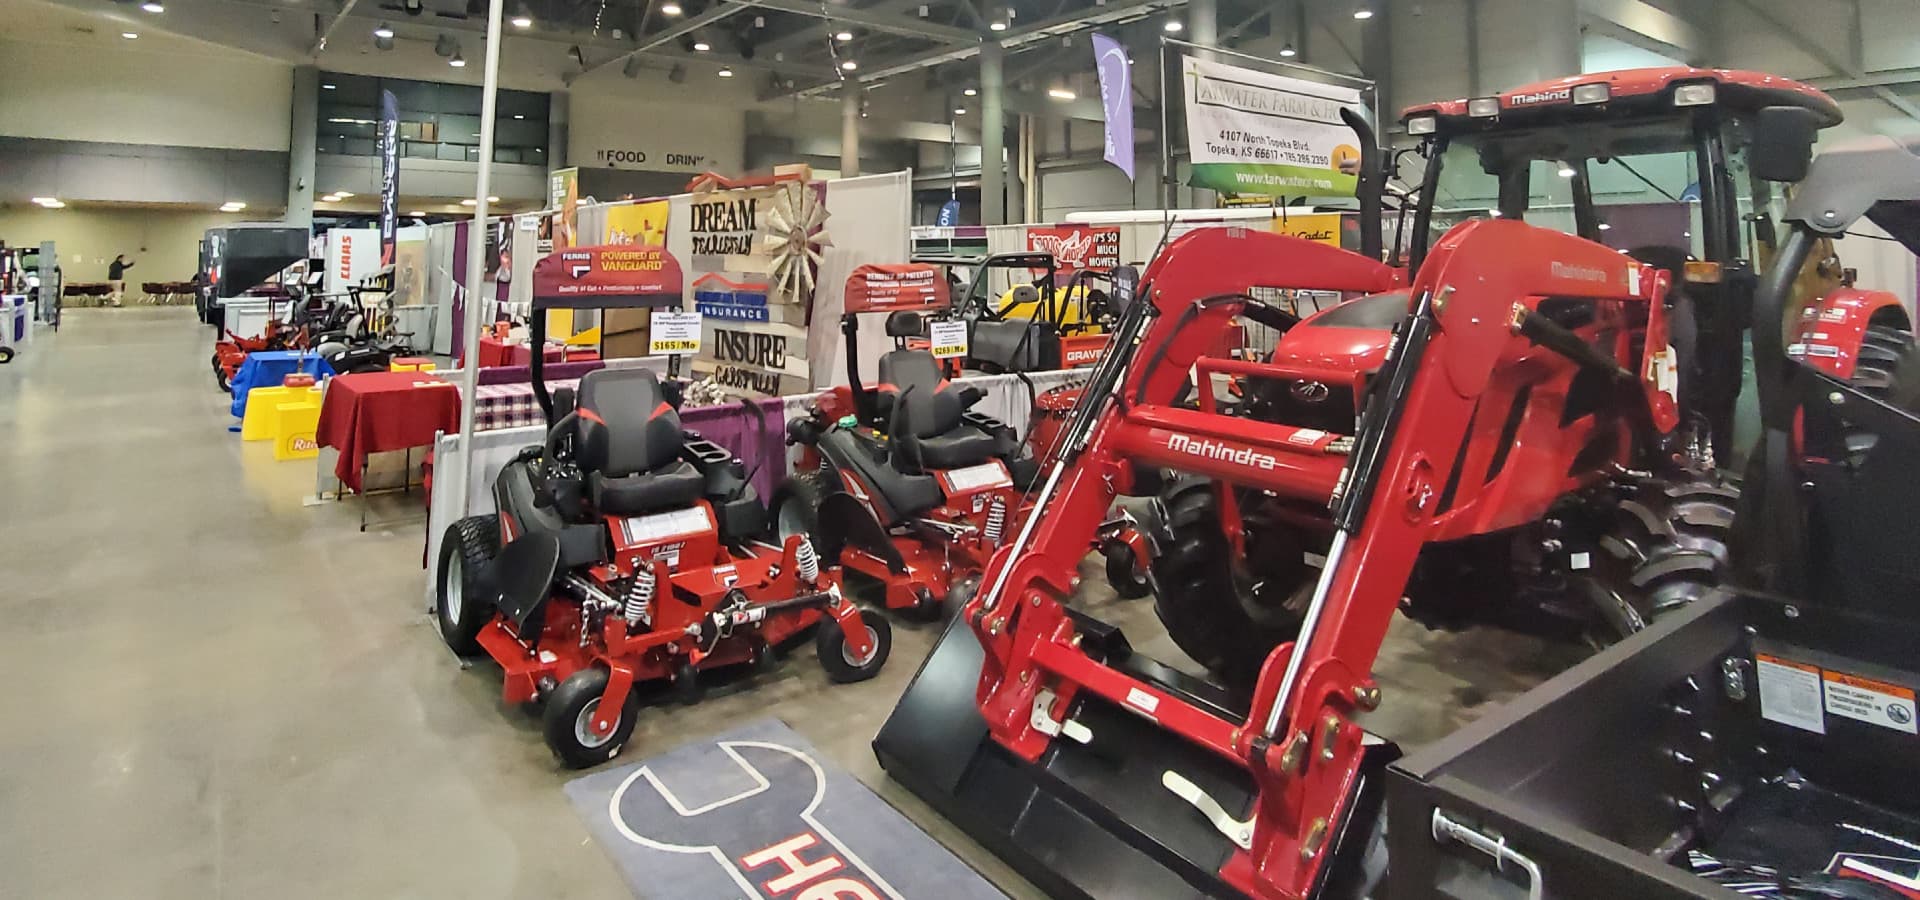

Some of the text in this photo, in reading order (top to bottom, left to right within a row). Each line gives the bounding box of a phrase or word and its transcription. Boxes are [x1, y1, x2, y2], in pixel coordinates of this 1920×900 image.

[1273, 93, 1307, 117] FARM
[1311, 105, 1321, 118] &
[1511, 89, 1570, 105] Mahind
[1219, 130, 1311, 151] 4107 North Topeka Blvd.
[606, 150, 646, 164] FOOD
[1206, 142, 1238, 157] Topeka,
[1241, 146, 1252, 158] KS
[1254, 148, 1278, 160] 66617
[690, 198, 756, 234] DREAM
[1106, 233, 1118, 243] SO
[341, 235, 352, 280] CLAAS
[601, 251, 660, 261] POWERED BY
[1096, 245, 1118, 255] MUCH
[601, 261, 662, 271] VANGUARD
[1551, 261, 1607, 282] Mahindra
[701, 305, 762, 320] INSURANCE
[714, 329, 786, 370] INSURE
[1067, 349, 1103, 361] GRAVE
[1168, 434, 1275, 471] Mahindra
